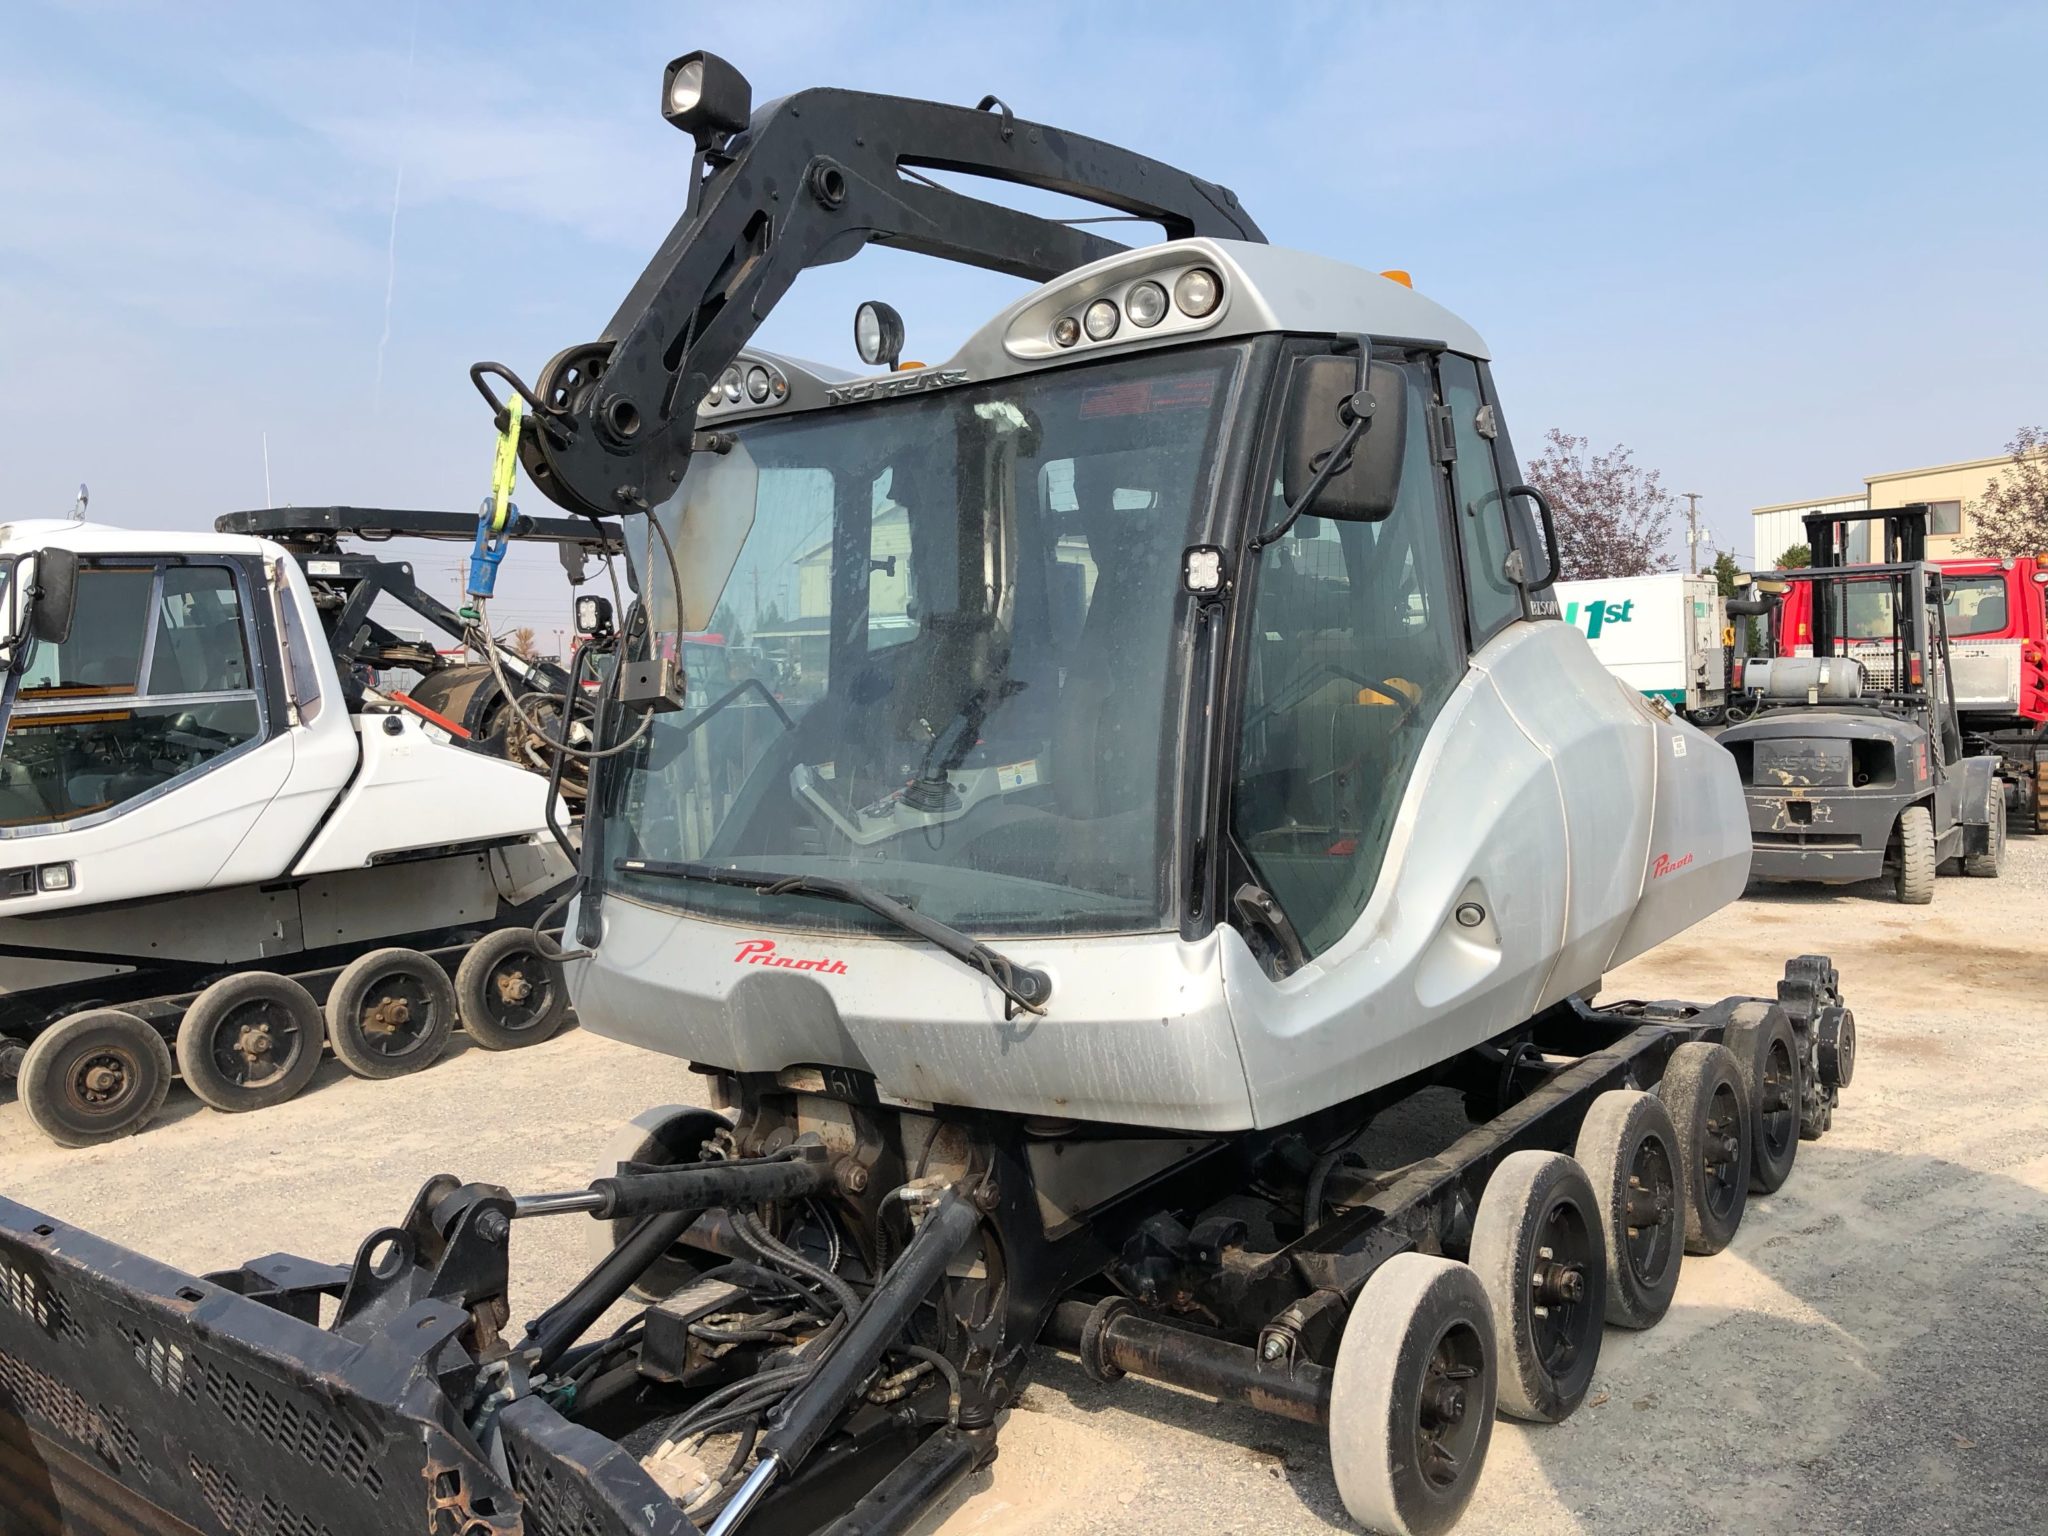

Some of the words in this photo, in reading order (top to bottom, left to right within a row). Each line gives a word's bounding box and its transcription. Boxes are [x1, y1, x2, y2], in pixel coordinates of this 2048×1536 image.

[1529, 600, 1560, 616] BISON
[1584, 598, 1634, 639] 1st
[1652, 852, 1694, 879] Prinoth
[734, 939, 848, 975] Prinoth
